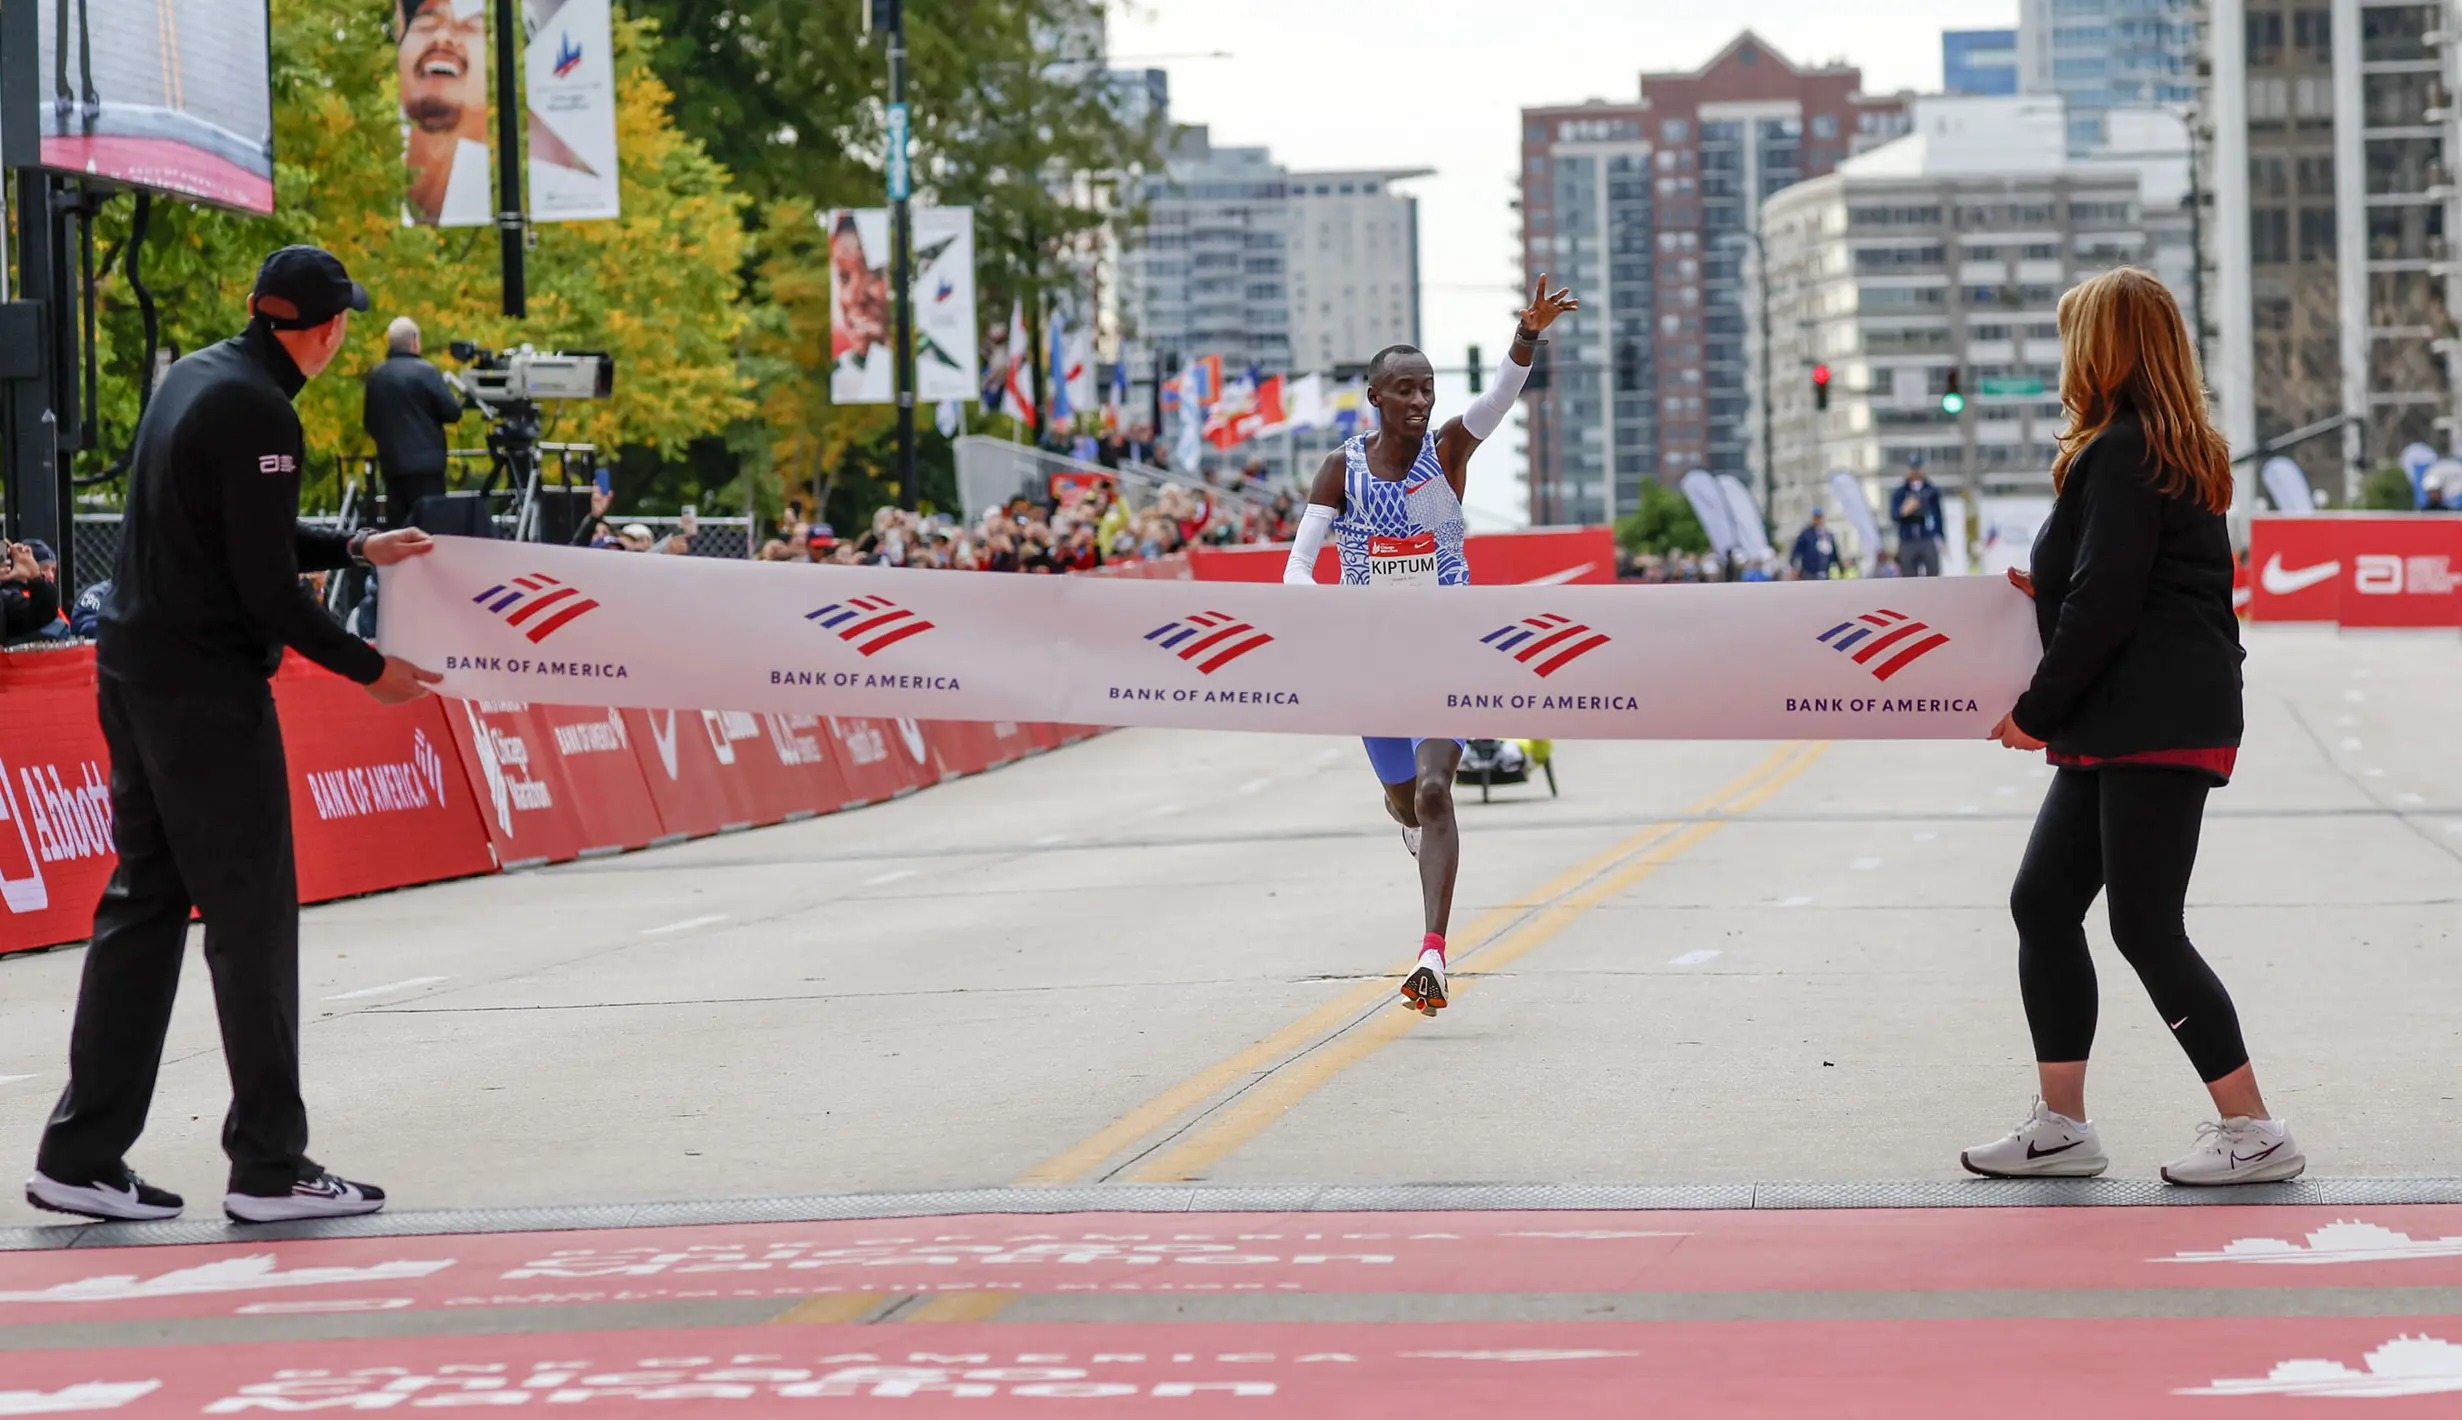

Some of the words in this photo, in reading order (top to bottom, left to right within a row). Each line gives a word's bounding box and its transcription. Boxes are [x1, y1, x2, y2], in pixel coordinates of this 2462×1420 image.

[1371, 556, 1435, 575] KIPTUM
[446, 655, 501, 671] BANK
[506, 658, 531, 673] OF
[536, 661, 628, 679] AMERICA
[770, 670, 827, 686] BANK
[833, 672, 860, 687] OF
[864, 674, 960, 691] AMERICA
[1109, 687, 1165, 701] BANK
[1172, 689, 1199, 702] OF
[1204, 690, 1300, 705] AMERICA
[1447, 694, 1504, 709] BANK
[1510, 694, 1537, 709] OF
[1542, 695, 1639, 711] AMERICA
[1785, 698, 1844, 713] BANK
[1849, 698, 1877, 713] OF
[1881, 698, 1979, 713] AMERICA
[306, 769, 357, 820] BANK
[347, 766, 373, 815] OF
[365, 761, 430, 812] AMERICA
[20, 760, 116, 862] Abbott
[201, 1380, 1278, 1414] Marathon
